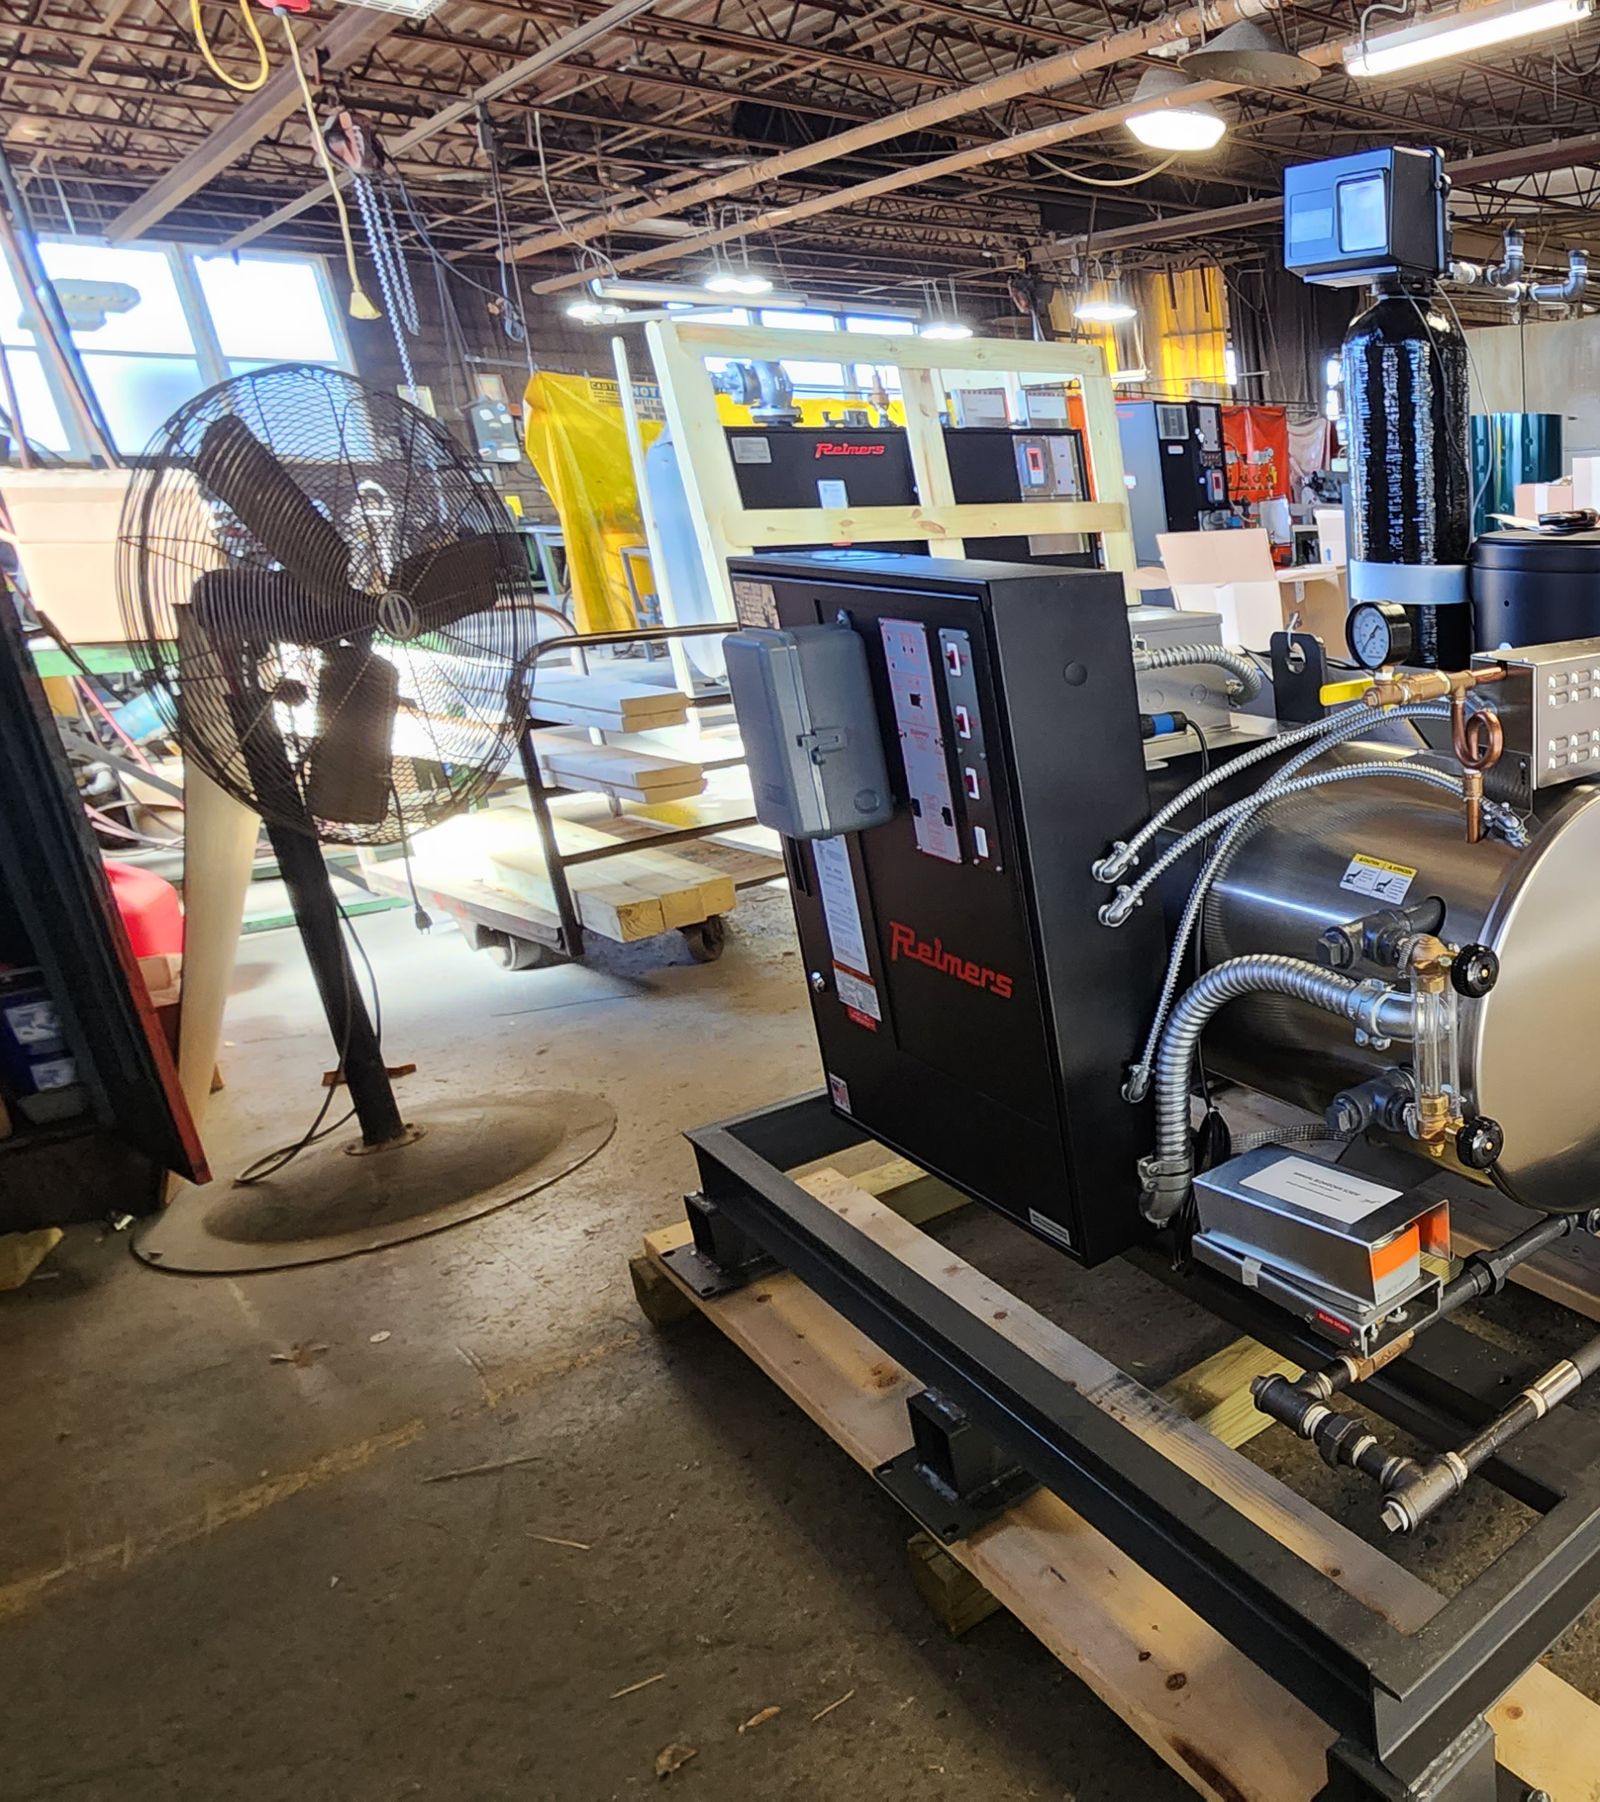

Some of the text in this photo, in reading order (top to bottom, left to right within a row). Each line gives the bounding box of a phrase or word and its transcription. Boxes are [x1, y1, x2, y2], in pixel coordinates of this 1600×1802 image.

[590, 382, 618, 391] CAUTI
[632, 386, 657, 397] NOT
[814, 442, 885, 459] Reimers
[889, 920, 1014, 999] Reimers
